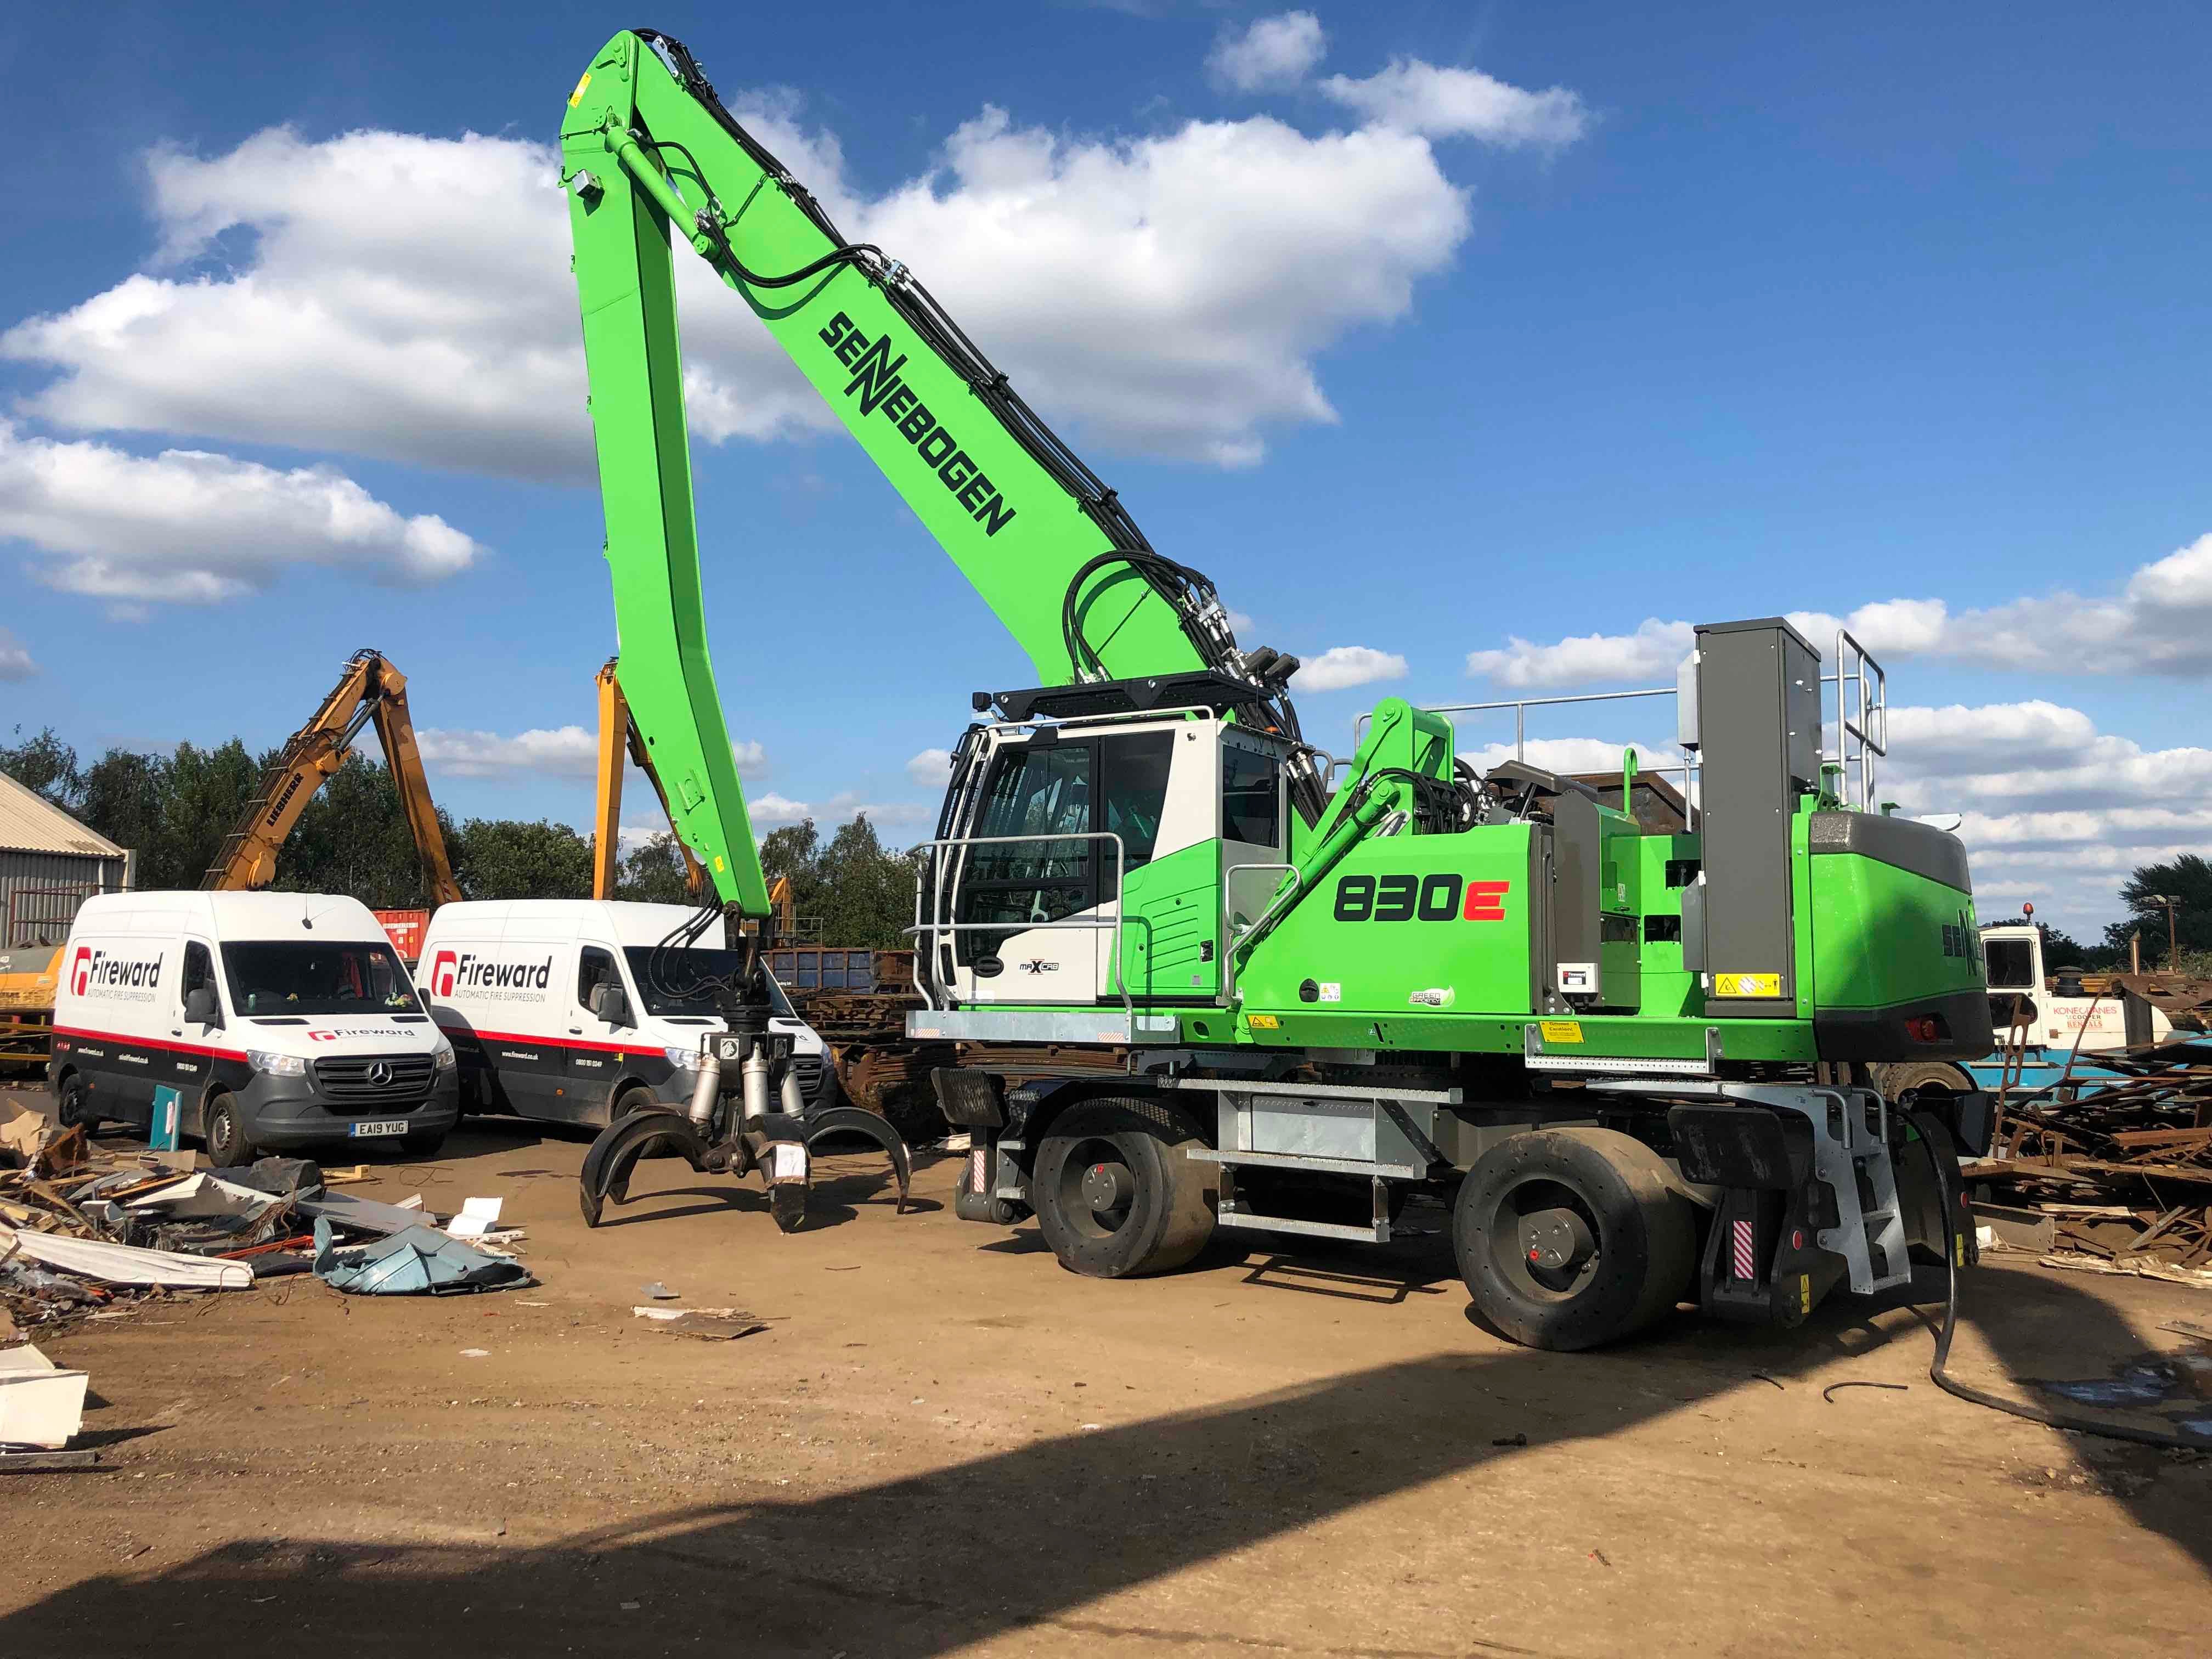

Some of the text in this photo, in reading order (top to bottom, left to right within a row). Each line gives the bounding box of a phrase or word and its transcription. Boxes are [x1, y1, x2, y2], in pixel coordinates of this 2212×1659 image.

[819, 311, 1017, 537] SENNEBOGEN
[266, 773, 304, 827] LIEBHERR
[1334, 874, 1510, 922] 830E
[89, 950, 163, 988] Fireward
[456, 954, 552, 989] Fireward
[87, 989, 157, 1002] AUTOMATIC FIRE SUPPRESSION
[454, 990, 546, 1002] AUTOMATIC FIRE SUPPRESSION
[359, 1122, 404, 1135] EA19 YUG
